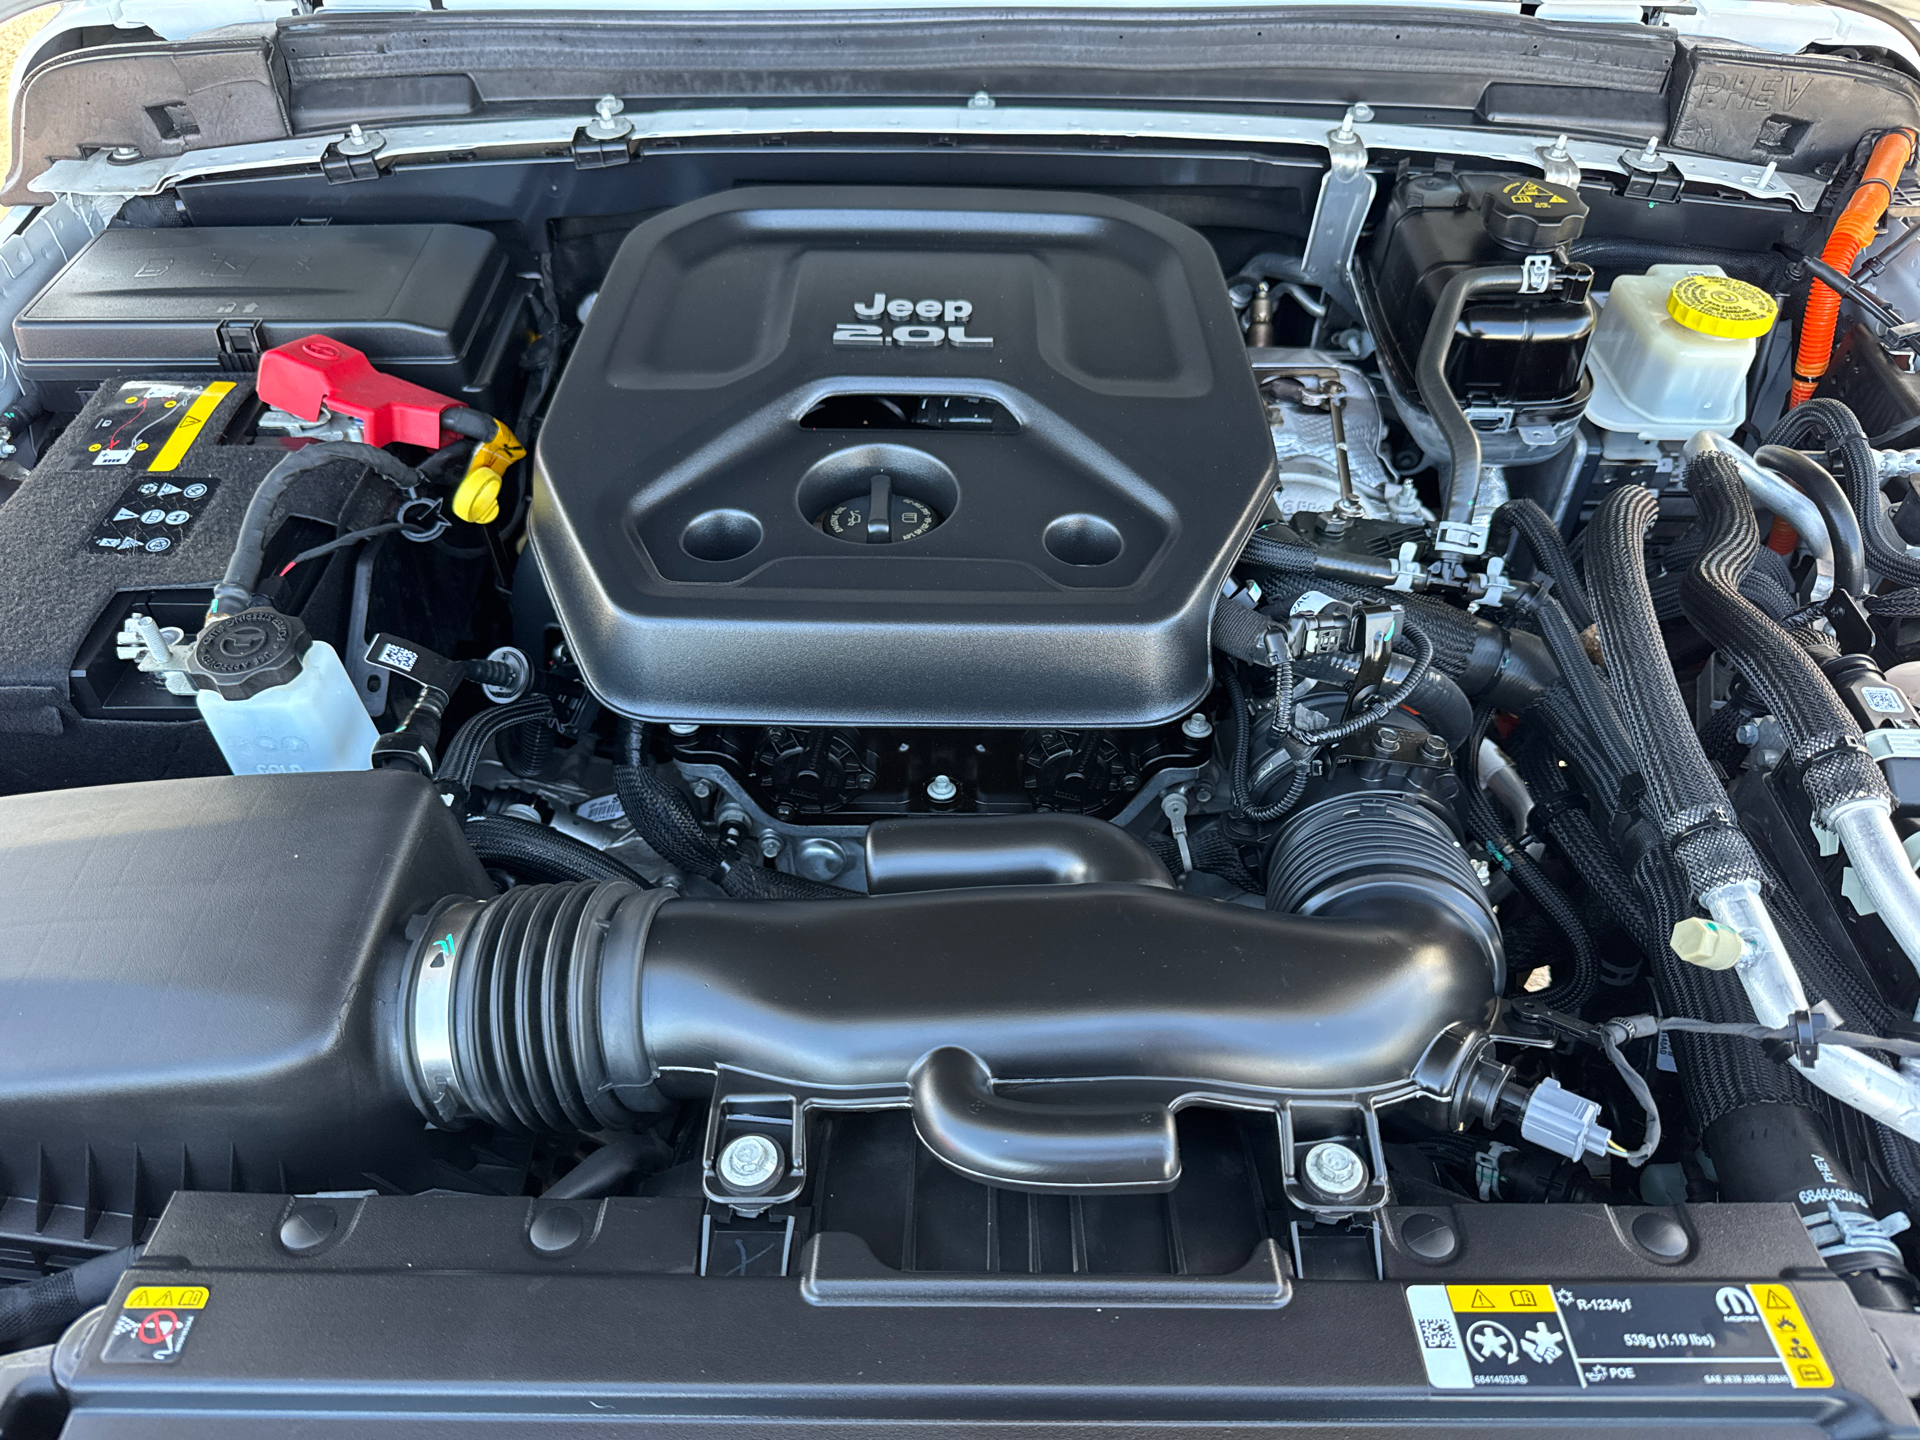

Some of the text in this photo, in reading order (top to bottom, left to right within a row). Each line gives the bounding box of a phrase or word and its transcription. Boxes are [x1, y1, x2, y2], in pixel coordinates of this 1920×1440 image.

[1695, 71, 1815, 112] PHEV
[854, 292, 973, 322] Jeep
[832, 323, 994, 347] 2.0L
[830, 506, 847, 533] ENGINE OIL
[225, 613, 274, 627] STEERING
[271, 619, 287, 642] POWER
[201, 651, 273, 671] USE APPROVED
[1811, 1153, 1838, 1183] PHEV
[1576, 1298, 1633, 1314] R-1234yf
[1623, 1333, 1716, 1349] 539g (1.19 lbs)
[1474, 1374, 1529, 1385] 68414033AB
[1609, 1366, 1637, 1380] POE
